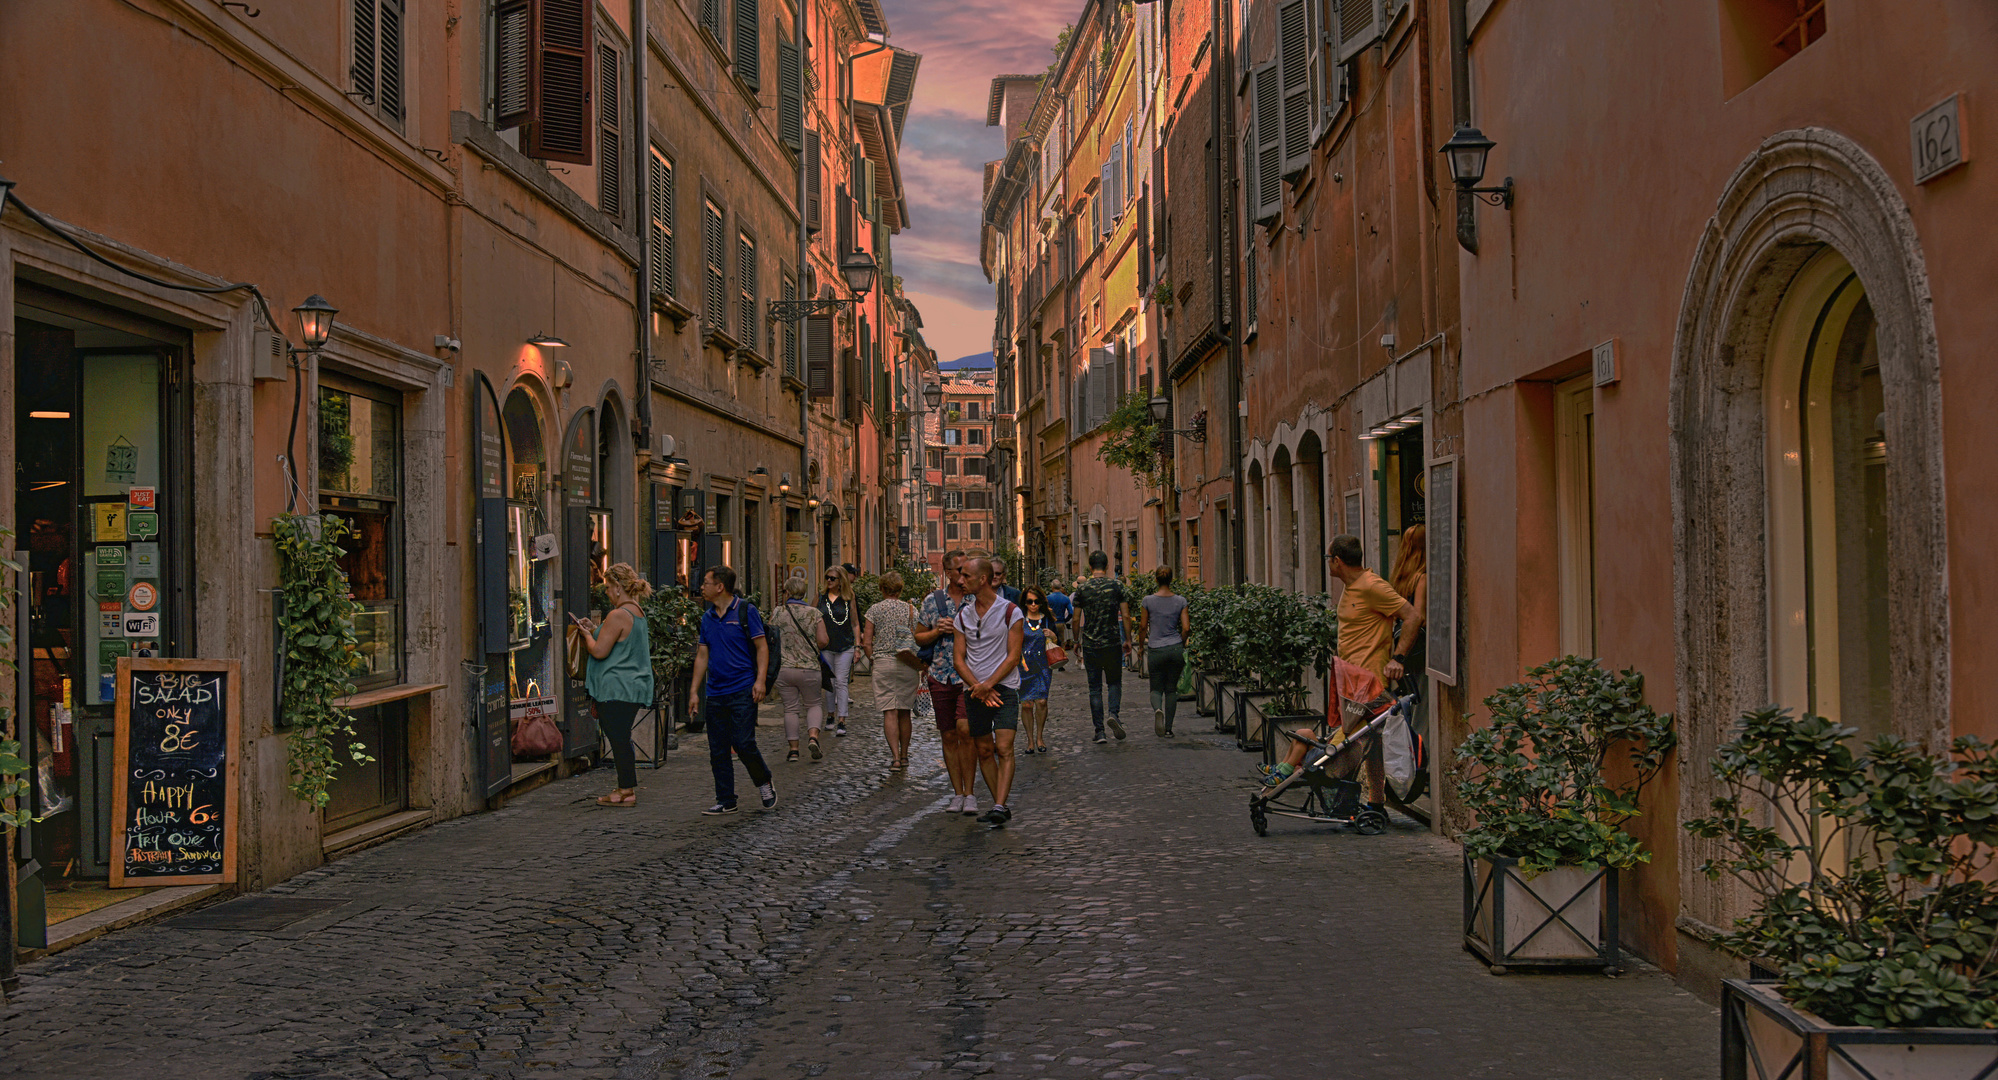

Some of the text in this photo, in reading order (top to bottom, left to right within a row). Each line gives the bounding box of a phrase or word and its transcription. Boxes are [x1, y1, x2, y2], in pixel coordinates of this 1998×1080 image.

[1918, 115, 1952, 168] 162
[1597, 349, 1610, 377] 161
[159, 672, 201, 690] BIG
[138, 686, 212, 704] SALAD
[532, 699, 554, 707] LEATHER
[526, 707, 541, 715] -50%
[160, 724, 199, 752] 8€
